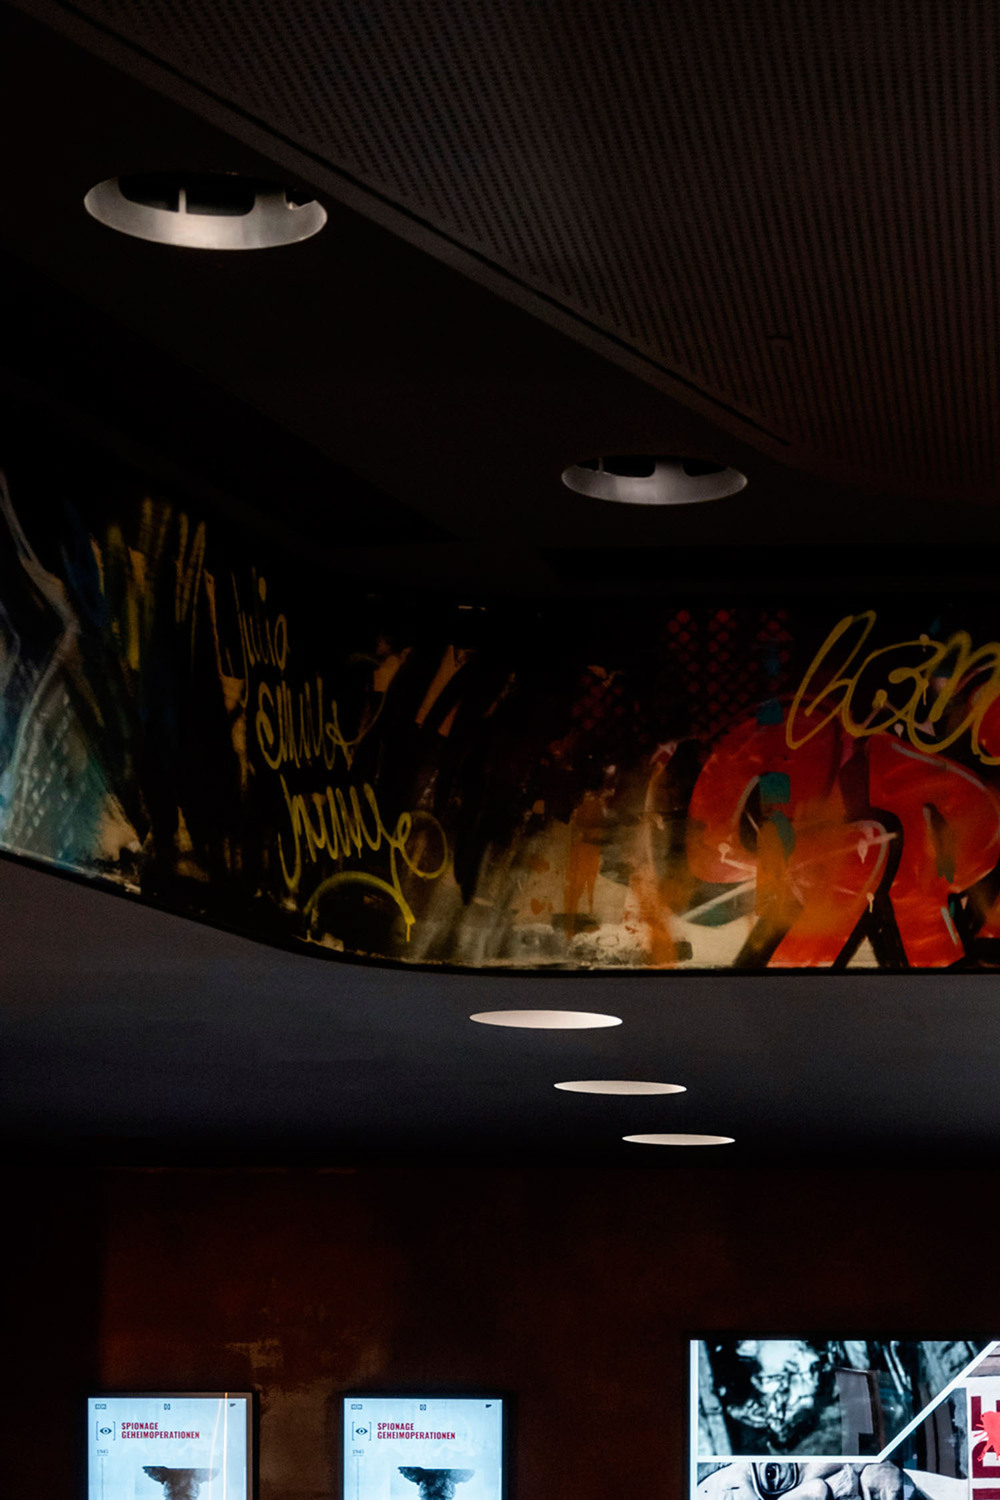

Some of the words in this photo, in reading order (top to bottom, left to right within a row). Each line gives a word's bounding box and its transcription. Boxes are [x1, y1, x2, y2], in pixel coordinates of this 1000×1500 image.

[121, 1422, 158, 1430] SPIONAGE
[377, 1422, 415, 1430] SPIONAGE
[121, 1431, 200, 1439] GEHEIMOPERATIONEN
[377, 1431, 456, 1440] GEHEIMOPERATIONEN
